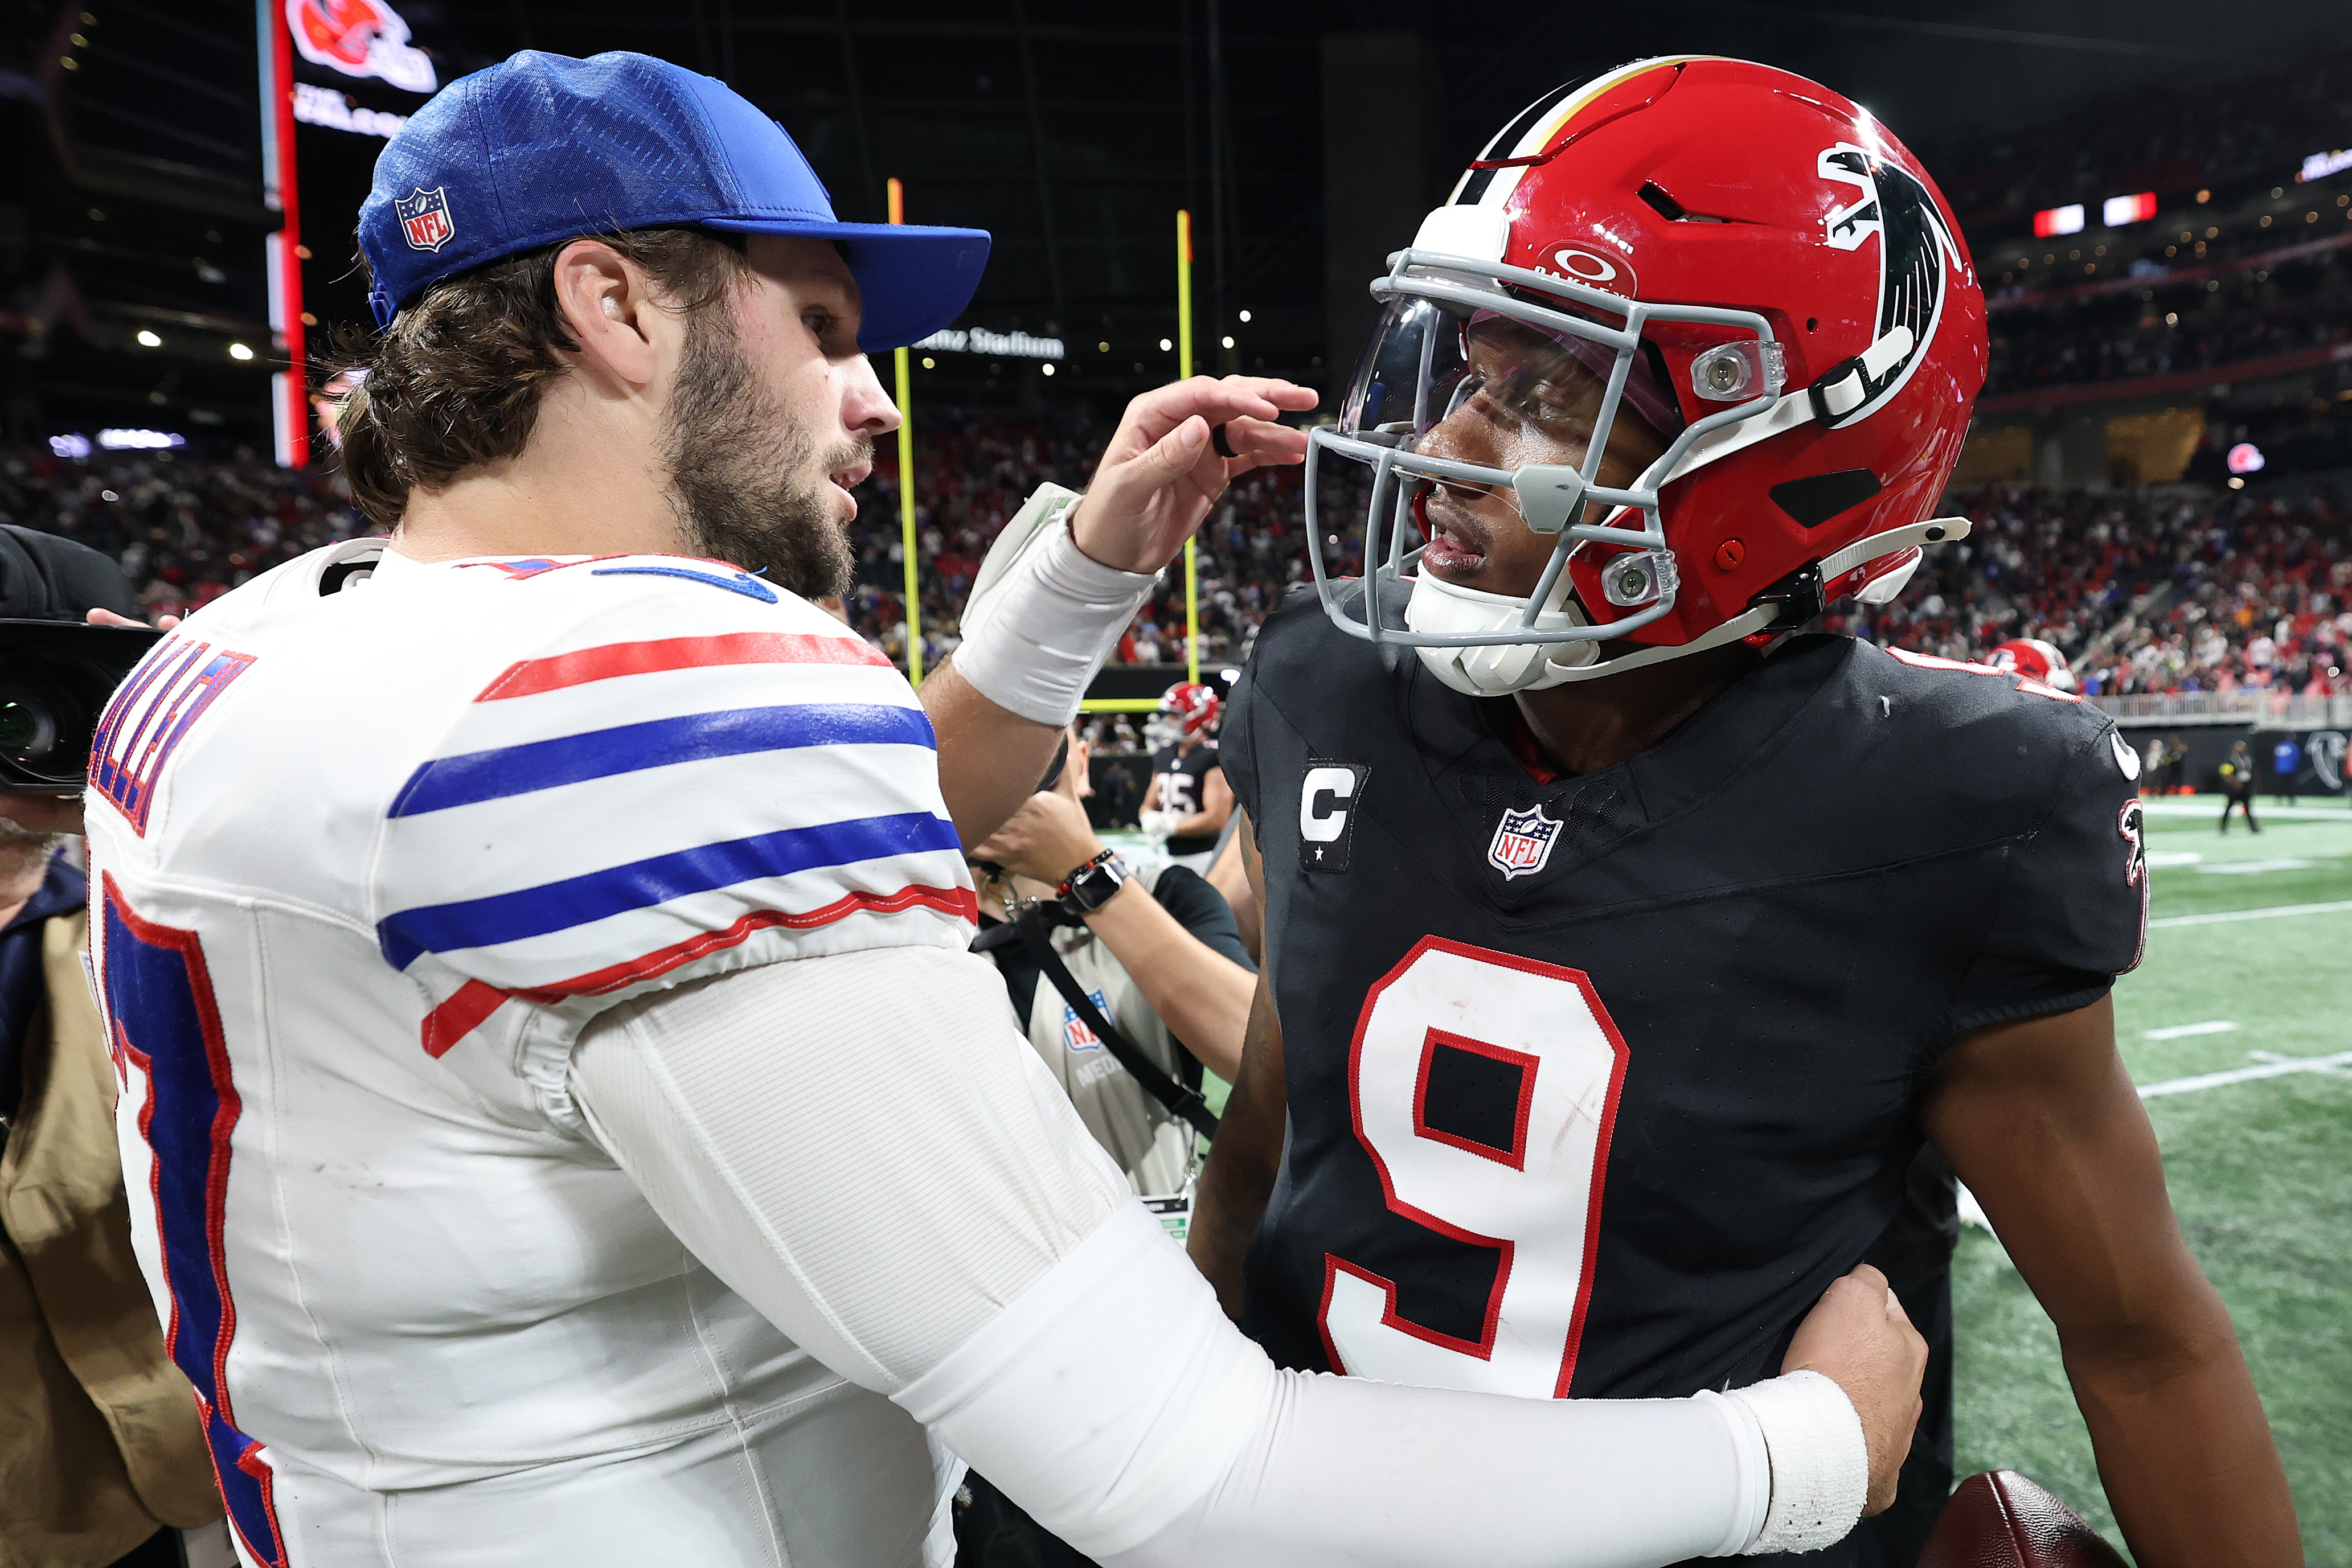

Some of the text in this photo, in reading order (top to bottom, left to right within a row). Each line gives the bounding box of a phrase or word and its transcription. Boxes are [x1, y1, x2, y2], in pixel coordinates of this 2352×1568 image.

[407, 212, 449, 243] NFL
[1300, 767, 1355, 842] C
[1497, 835, 1538, 865] NFL
[1317, 934, 1631, 1399] 9
